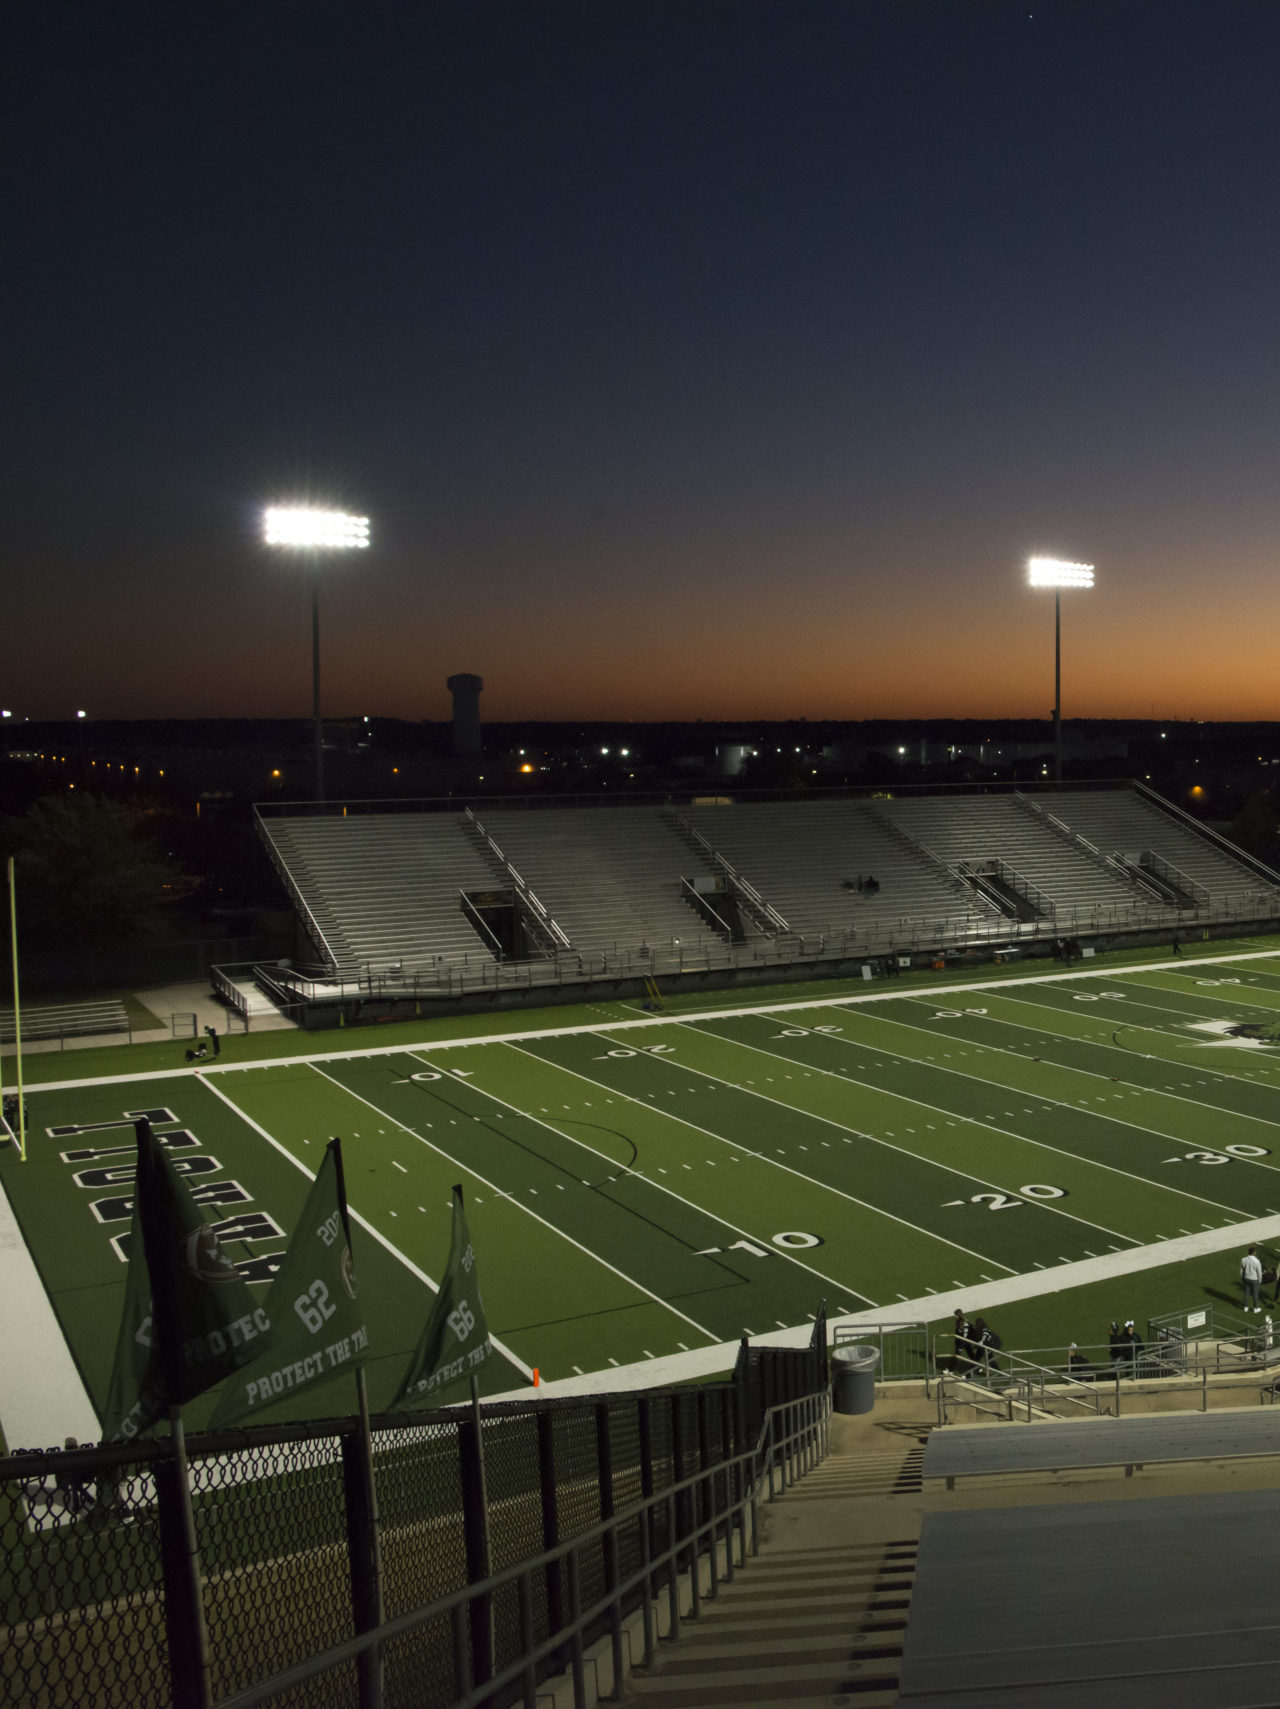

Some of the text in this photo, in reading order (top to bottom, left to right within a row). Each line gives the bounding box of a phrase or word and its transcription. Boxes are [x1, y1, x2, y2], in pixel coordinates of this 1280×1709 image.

[935, 1007, 988, 1018] 40
[780, 1025, 843, 1037] 30
[607, 1044, 676, 1058] 20
[410, 1068, 475, 1081] 10
[1184, 1144, 1268, 1165] 30
[970, 1184, 1065, 1211] 20
[727, 1231, 821, 1258] 10
[294, 1279, 337, 1335] 62
[446, 1299, 476, 1343] 66
[467, 1344, 486, 1369] THE
[245, 1351, 324, 1406] PROTECT
[325, 1337, 351, 1368] THE
